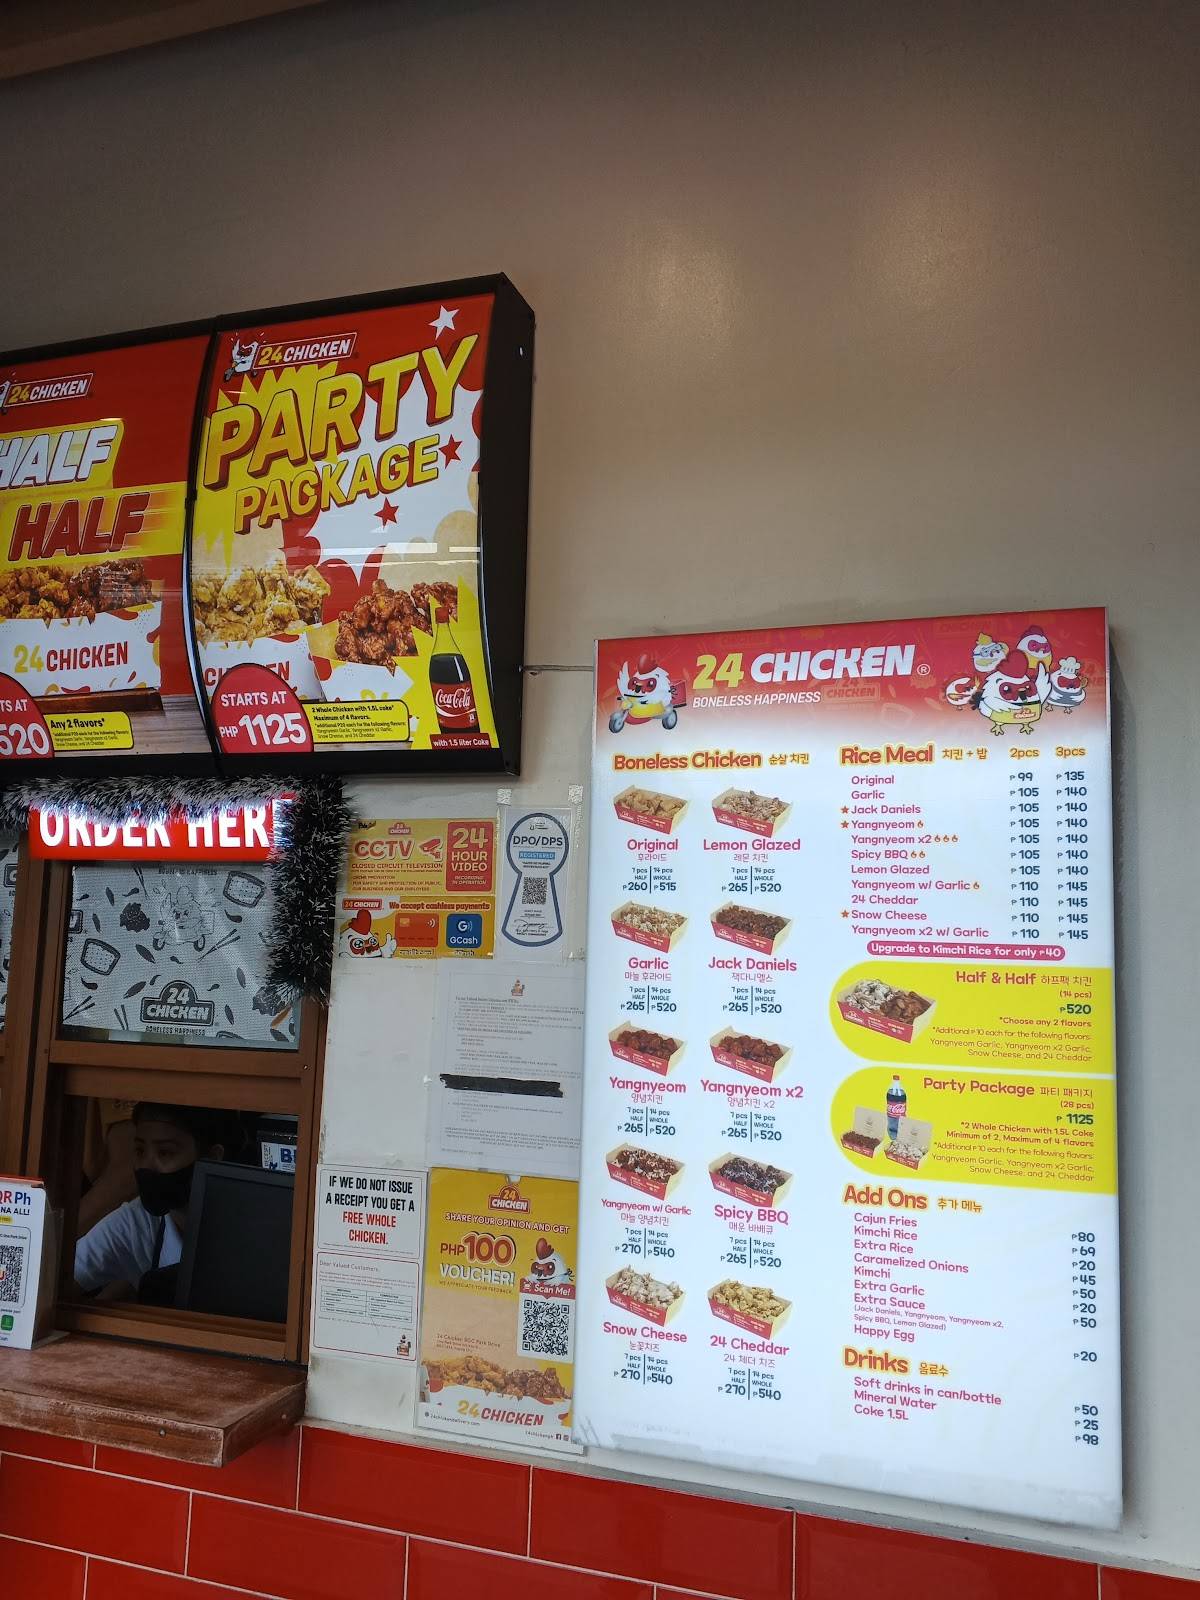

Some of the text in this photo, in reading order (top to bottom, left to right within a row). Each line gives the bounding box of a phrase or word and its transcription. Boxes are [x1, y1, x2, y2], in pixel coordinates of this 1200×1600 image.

[203, 334, 479, 490] PARTY
[235, 434, 440, 534] PACKAGE
[9, 492, 151, 561] HALF
[46, 641, 128, 672] CHICKEN
[693, 645, 915, 689] 24 CHICKEN
[15, 699, 28, 712] AT
[220, 691, 287, 706] STARTS AT
[693, 692, 821, 708] BONELESS HAPPINESS
[50, 719, 66, 730] Any
[66, 720, 74, 728] 2
[219, 726, 239, 738] PHP
[239, 713, 306, 746] 1125
[614, 752, 762, 770] Boneless Chicken
[841, 745, 933, 764] Rice Meal
[1010, 746, 1086, 760] 2pcs 3pcs
[851, 775, 895, 786] Original
[851, 790, 885, 800] Garlic
[851, 804, 921, 814] Jack Daniels
[39, 806, 170, 848] ORDER
[851, 819, 915, 832] Yangnyeom
[452, 828, 488, 849] 24
[512, 836, 563, 846] DPO/DPS
[627, 838, 678, 853] Original
[703, 838, 800, 851] Lemon Glazed
[851, 834, 932, 846] Yangnyeom x2
[354, 840, 414, 860] CCTV
[452, 852, 488, 862] HOUR
[851, 848, 908, 862] Spicy BBQ
[452, 862, 488, 872] VIDEO
[851, 864, 930, 875] Lemon Glazed
[851, 879, 971, 892] Yangnyeom w/ Garlic
[851, 894, 918, 905] 24 Cheddar
[851, 909, 928, 920] Snow Cheese
[851, 924, 989, 938] Yangnyeom x2 w/ Garlic
[450, 936, 478, 944] GCash
[871, 943, 1036, 958] Upgrade to Kimchi Rice for only
[628, 956, 669, 970] Garlic
[708, 956, 797, 971] Jack Daniels
[956, 970, 1036, 986] Half & Half
[169, 986, 190, 1003] 24
[147, 1005, 210, 1020] CHICKEN
[610, 1076, 686, 1094] Yangnyeom
[701, 1080, 804, 1098] Yangnyeom x2
[924, 1077, 1035, 1096] Party Package
[329, 1176, 413, 1194] IF WE DO NOT ISSUE
[14, 1192, 31, 1206] Ph
[326, 1192, 415, 1212] A RECEIPT YOU GET A
[502, 1189, 516, 1199] 24
[844, 1186, 928, 1210] Add Ons
[492, 1199, 528, 1211] CHICKEN
[602, 1199, 692, 1216] Yangnyeom Garlic
[938, 1198, 982, 1212] 추가 메뉴
[343, 1212, 396, 1228] FREE WHOLE
[714, 1204, 789, 1225] Spicy BBQ
[854, 1212, 918, 1227] Cajun Fries
[446, 1213, 570, 1234] SHARE YOUR OPINION AND GET
[349, 1229, 389, 1245] CHICKEN.
[854, 1226, 918, 1240] Kimchi Rice
[441, 1242, 465, 1256] PHP
[464, 1233, 516, 1266] 100
[854, 1240, 914, 1254] Extra Rice
[854, 1253, 969, 1273] Caramelized Onions
[440, 1263, 515, 1286] VOUCHER!
[854, 1266, 890, 1278] Kimchi
[534, 1282, 571, 1296] Scan Me!
[854, 1280, 925, 1296] Extra Garlic
[854, 1294, 926, 1310] Extra Sauce
[604, 1322, 688, 1342] Snow Cheese
[854, 1324, 914, 1342] Happy Egg
[710, 1336, 790, 1356] 24 Cheddar
[844, 1348, 909, 1373] Drinks
[854, 1376, 1002, 1405] Soft drinks in can/bottle
[854, 1390, 936, 1410] Mineral Water
[456, 1400, 481, 1418] 24
[481, 1407, 544, 1427] CHICKEN
[854, 1404, 909, 1421] Coke 1.5L
